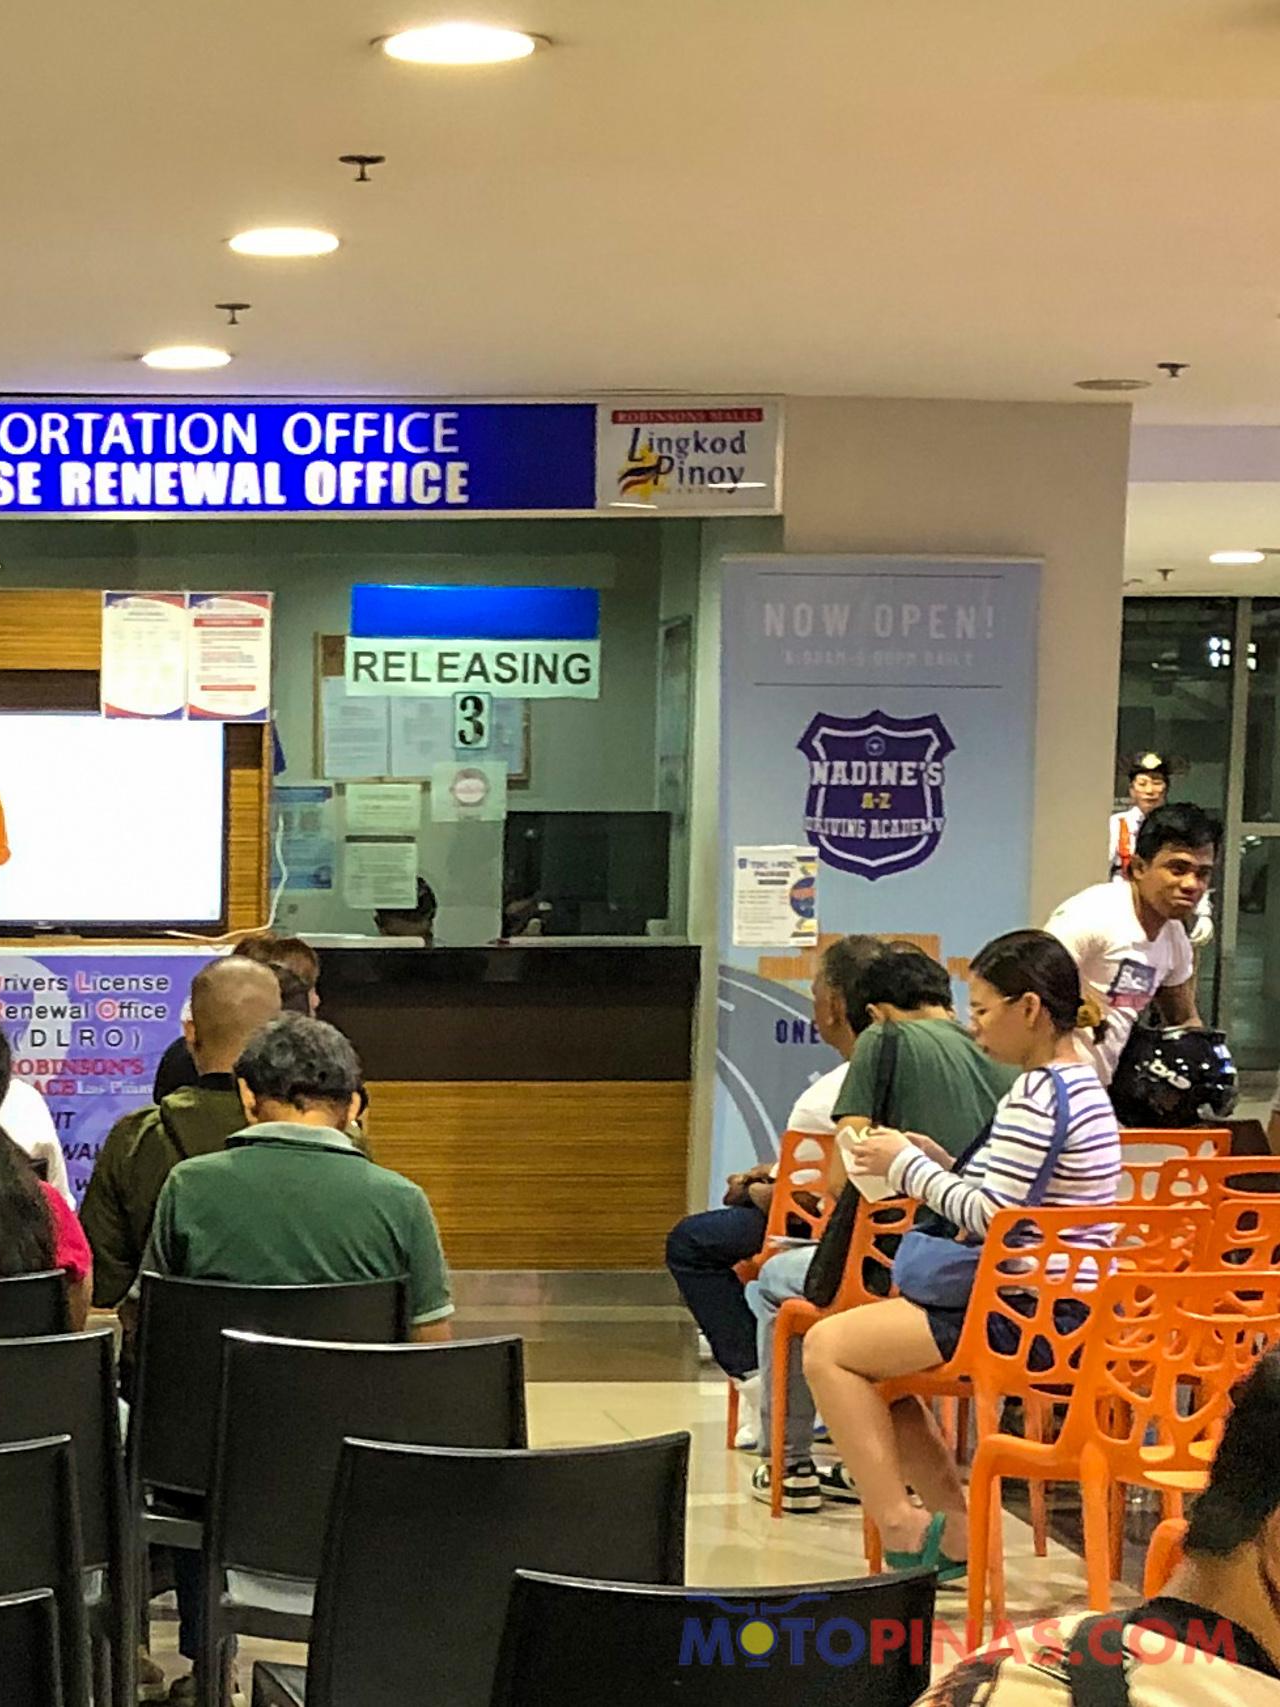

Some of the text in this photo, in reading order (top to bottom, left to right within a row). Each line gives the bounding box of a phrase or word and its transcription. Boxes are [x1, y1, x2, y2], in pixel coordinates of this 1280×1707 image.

[282, 412, 459, 454] OFFICE
[618, 411, 708, 422] ROBINSONS
[628, 428, 746, 462] Lingkod
[60, 461, 286, 505] RENEWAL
[304, 461, 469, 505] OFFICE
[652, 456, 746, 494] Pinoy
[764, 603, 995, 639] NOW OPEN!
[352, 651, 592, 685] RELEASING
[458, 695, 484, 745] 3
[810, 760, 945, 786] NADINE'S
[860, 792, 892, 810] A-Z
[868, 816, 946, 839] ACADEMY
[75, 971, 169, 992] License
[96, 999, 167, 1019] Office
